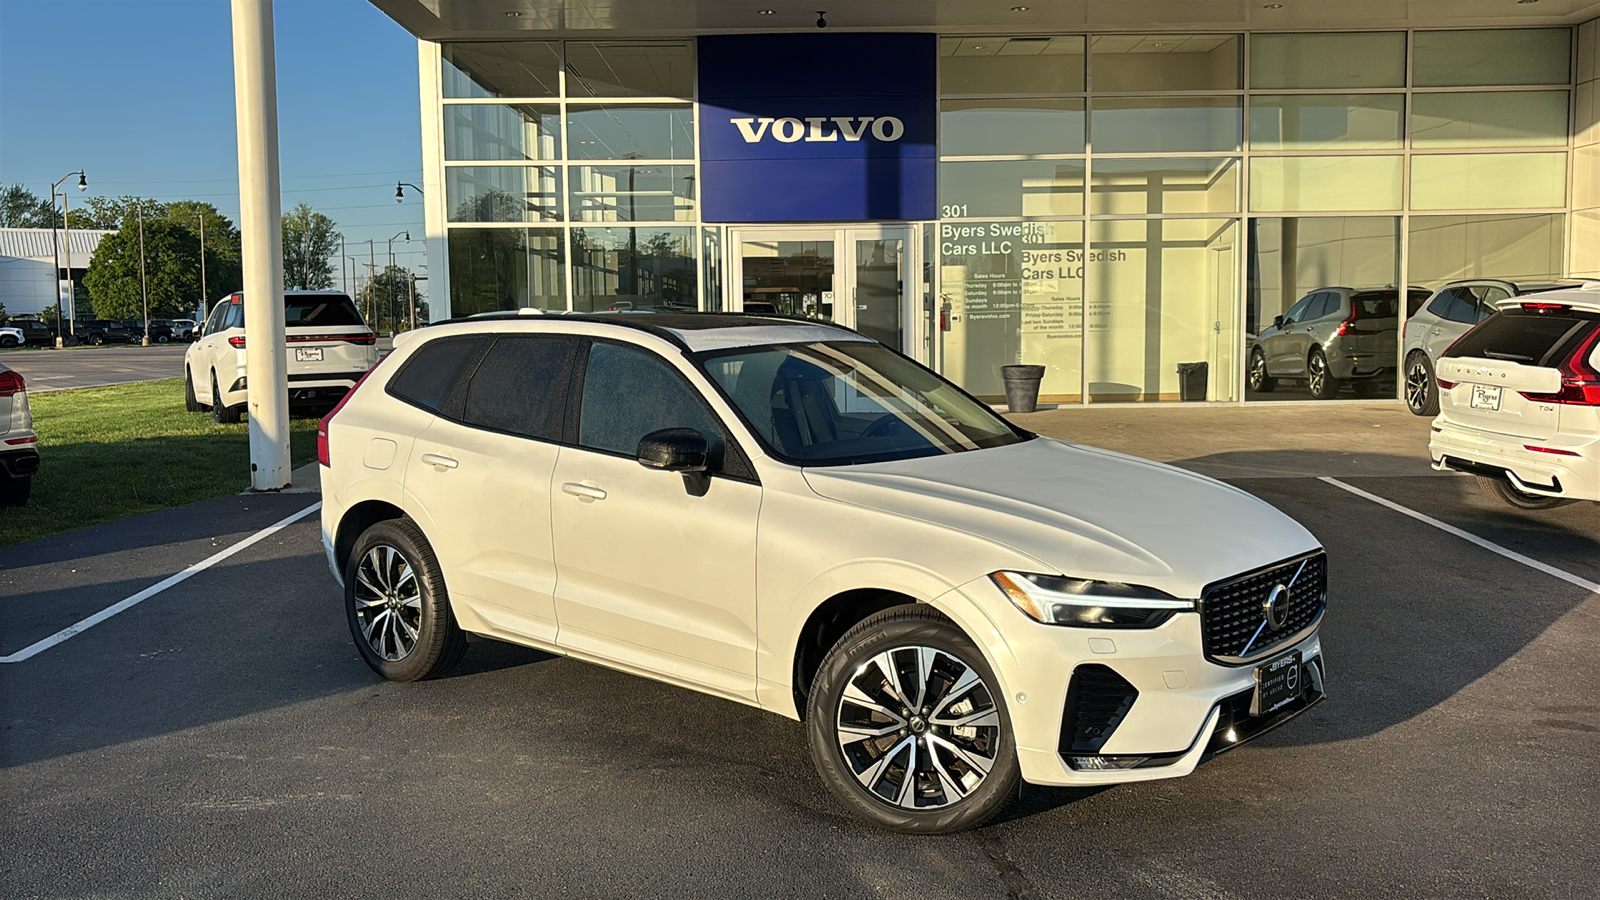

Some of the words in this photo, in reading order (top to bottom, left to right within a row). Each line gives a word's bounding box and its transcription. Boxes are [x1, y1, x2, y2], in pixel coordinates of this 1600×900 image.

[730, 116, 904, 143] VOLVO
[942, 204, 967, 218] 301
[942, 224, 985, 241] Byers
[990, 223, 1054, 237] Swedish
[1021, 233, 1045, 245] 301
[942, 242, 977, 256] Cars
[982, 241, 1012, 255] LLC
[1021, 251, 1062, 266] Byers
[1021, 267, 1054, 280] Cars
[992, 281, 1012, 289] 9:00am
[1271, 655, 1293, 671] BYERS
[1262, 674, 1285, 690] CERTIFIED
[1262, 691, 1269, 699] BY
[1270, 684, 1283, 695] VOLVO
